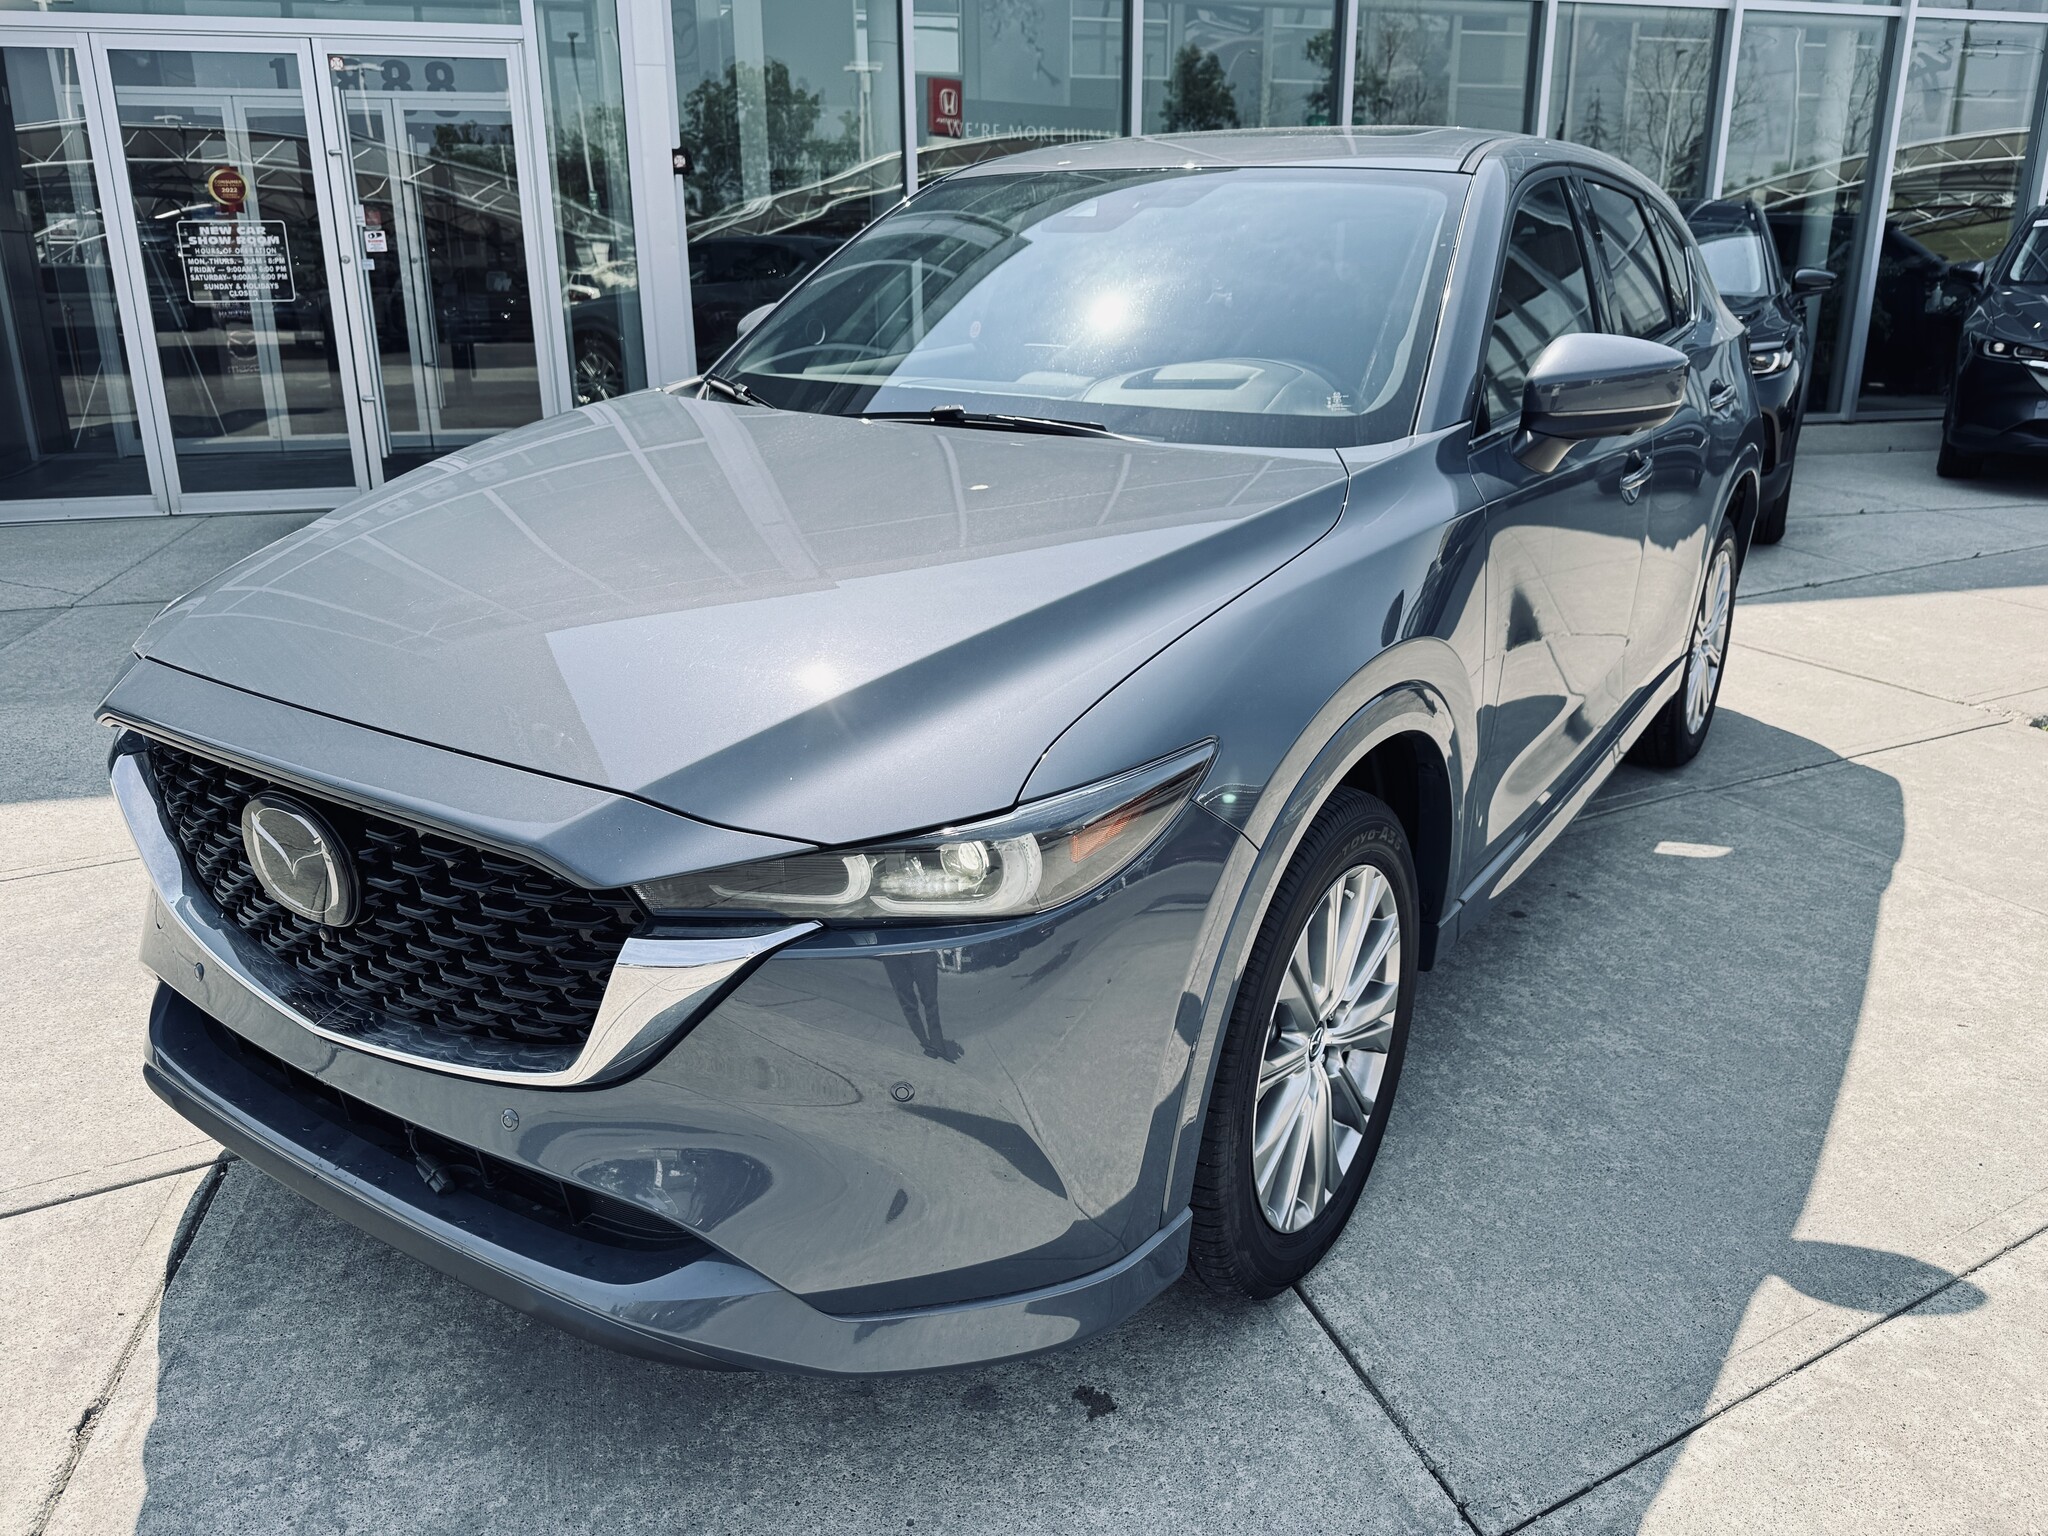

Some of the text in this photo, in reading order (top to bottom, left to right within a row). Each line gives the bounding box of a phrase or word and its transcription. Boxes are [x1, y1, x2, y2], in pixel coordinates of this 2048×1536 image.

[947, 119, 1000, 138] WE'RE
[1009, 124, 1057, 142] MORE
[199, 226, 267, 235] NEW CAR
[188, 236, 280, 245] SHOW ROOM
